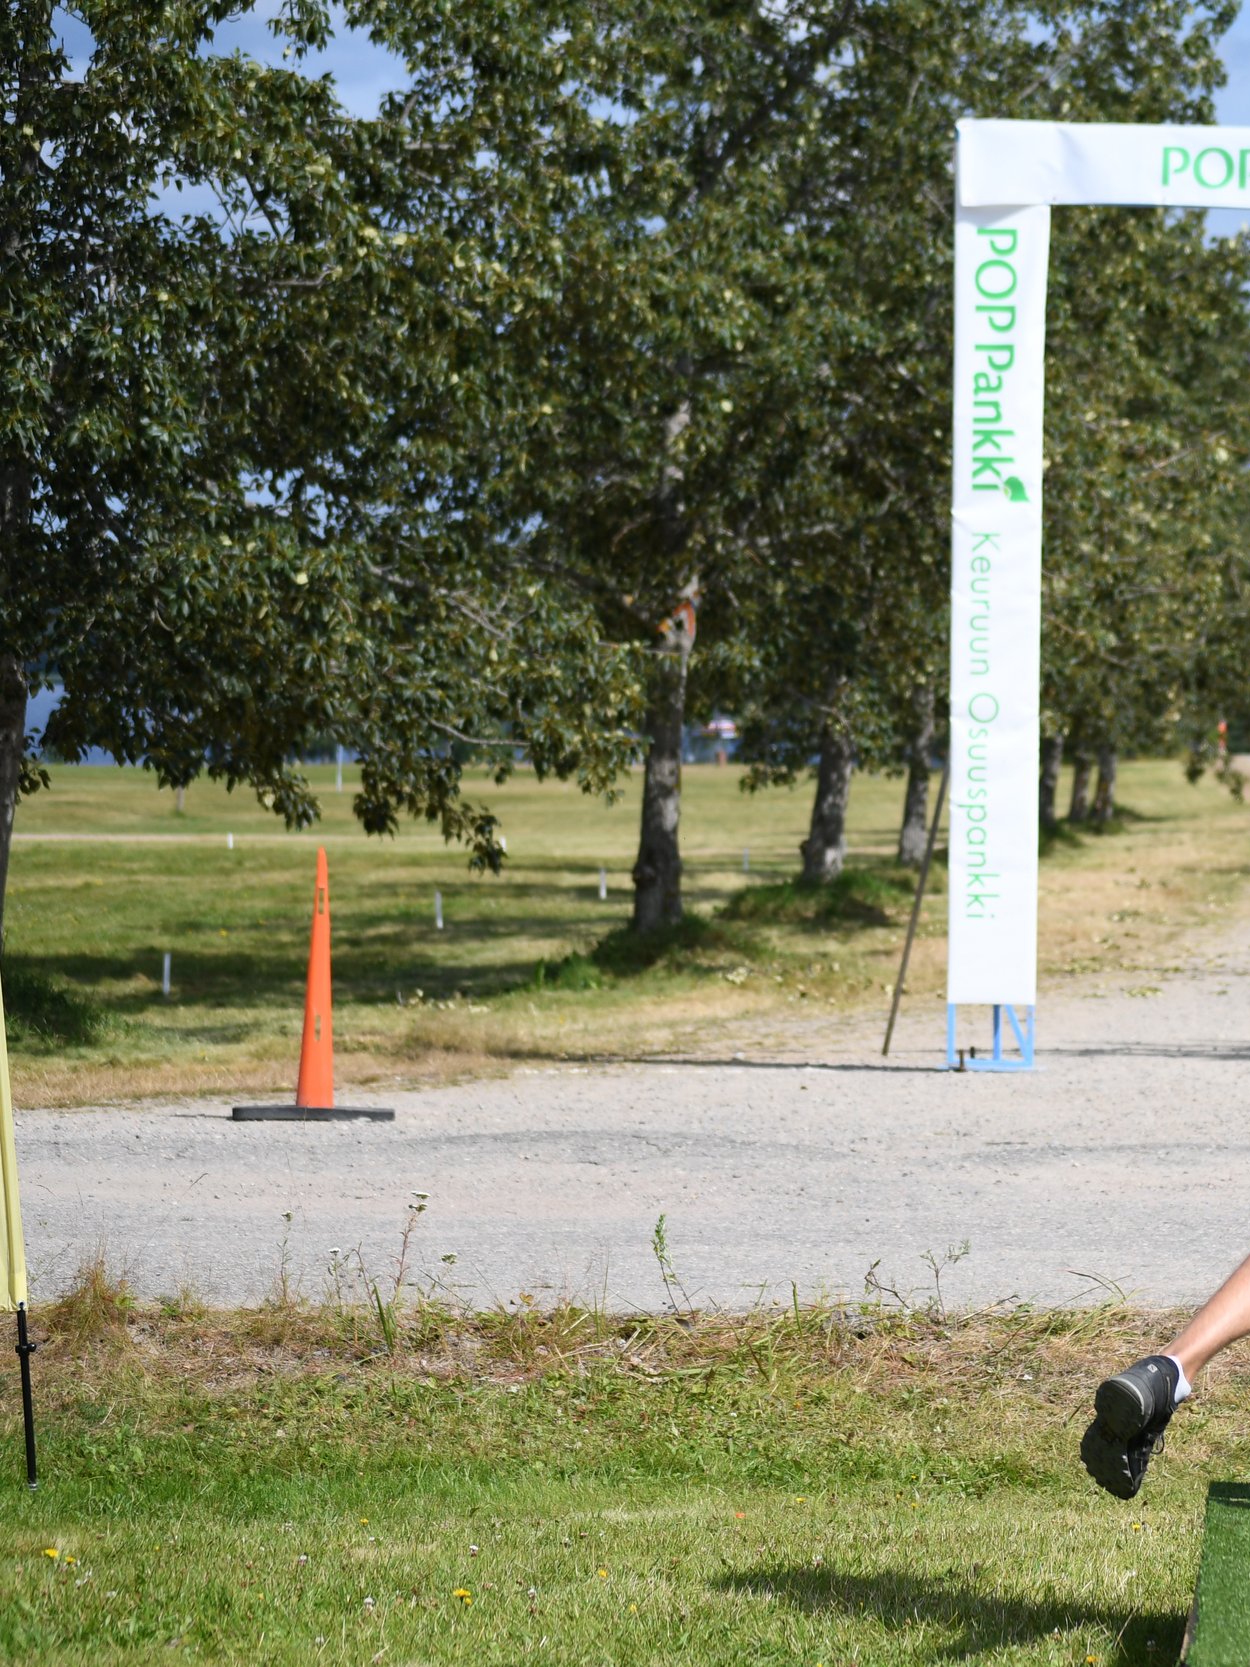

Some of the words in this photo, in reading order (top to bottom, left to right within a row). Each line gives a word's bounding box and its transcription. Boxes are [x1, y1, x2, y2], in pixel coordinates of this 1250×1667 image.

[974, 226, 1019, 333] POP
[971, 344, 1017, 492] Pankki
[969, 531, 1001, 676] Keuruun
[957, 692, 1001, 919] Osuuspankki
